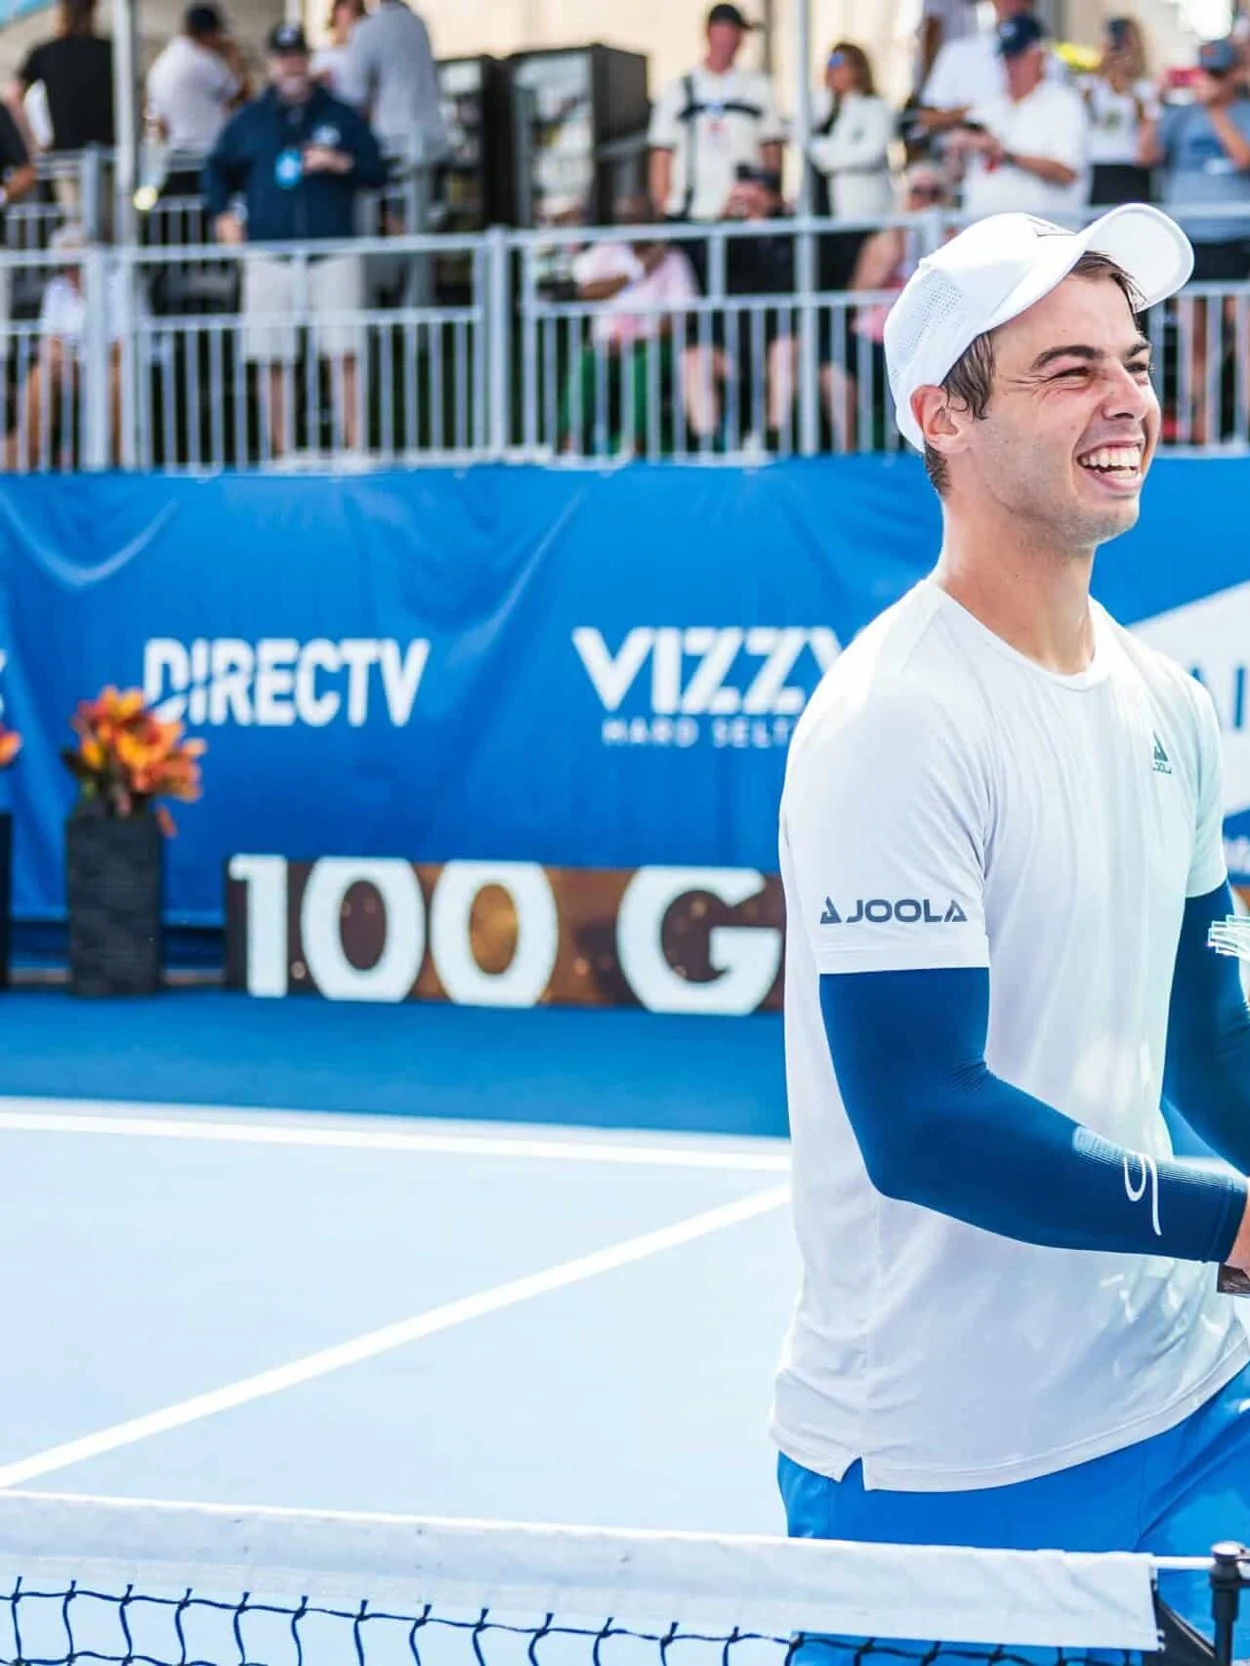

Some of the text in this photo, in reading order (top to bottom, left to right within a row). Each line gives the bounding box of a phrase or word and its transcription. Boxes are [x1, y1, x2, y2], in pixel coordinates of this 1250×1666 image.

[144, 637, 431, 727] DIRECTV
[602, 716, 797, 748] HARD SELT
[228, 854, 558, 1009] 100
[617, 865, 781, 1015] G
[846, 898, 968, 923] JOOLA
